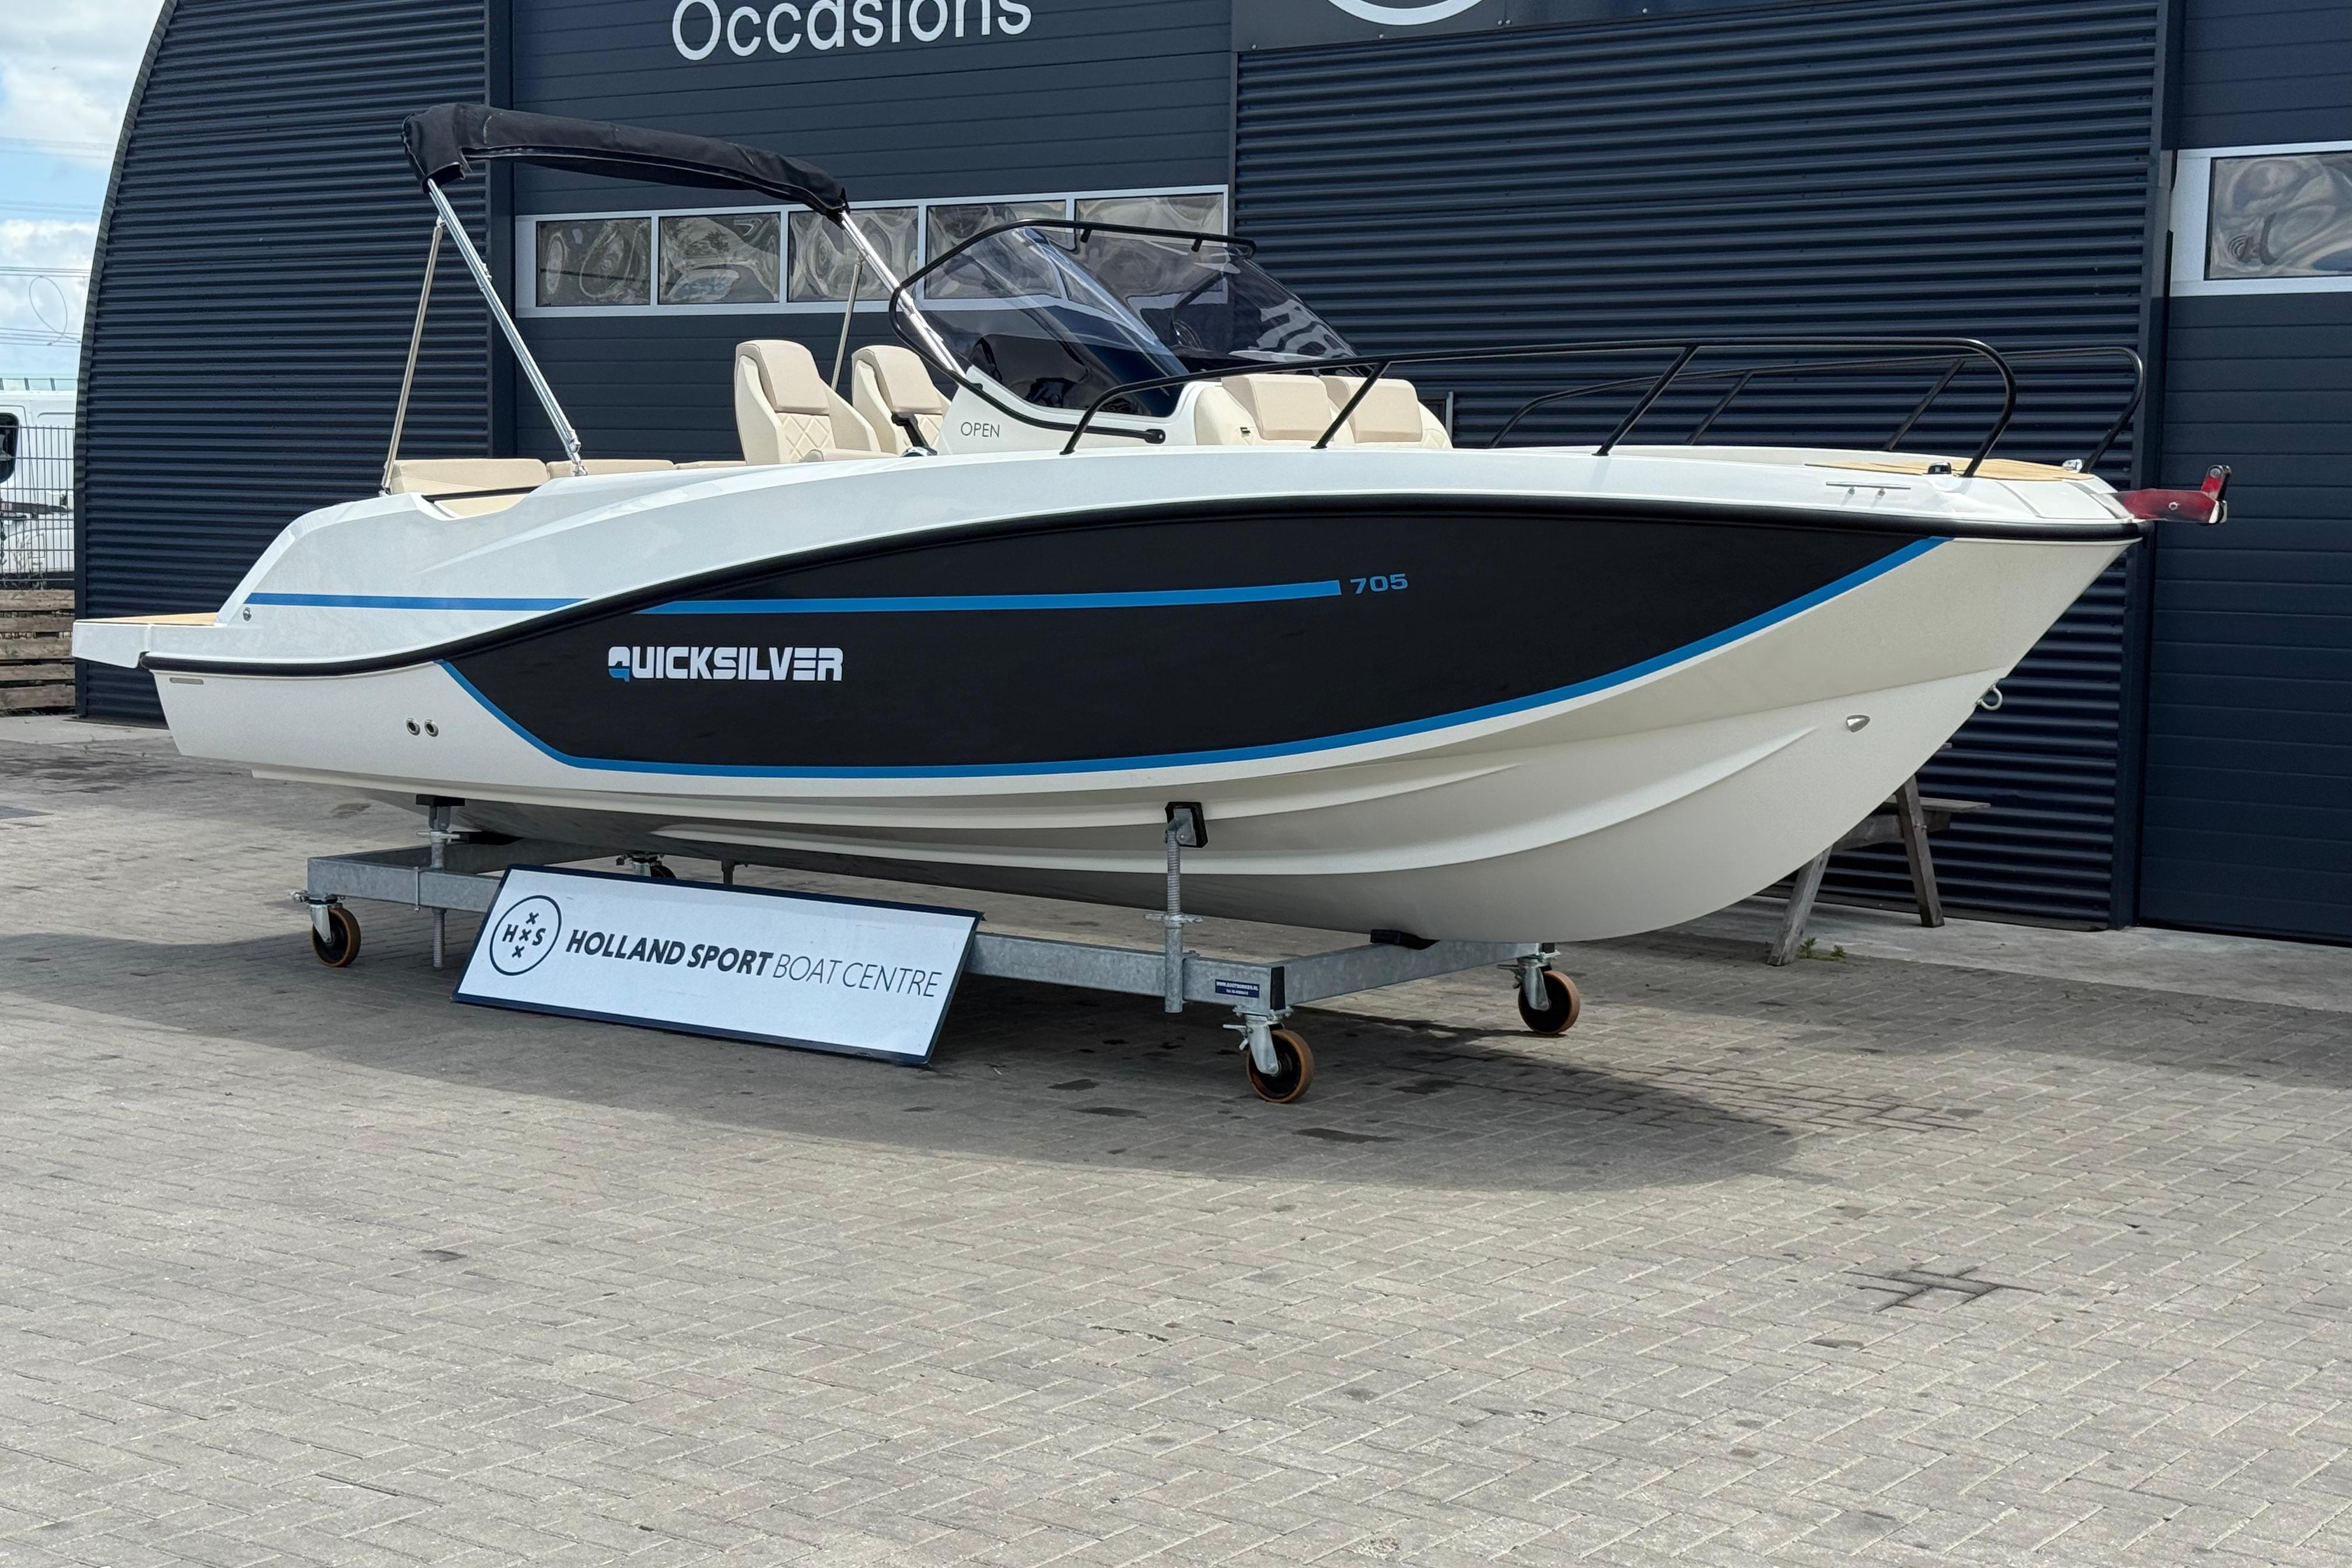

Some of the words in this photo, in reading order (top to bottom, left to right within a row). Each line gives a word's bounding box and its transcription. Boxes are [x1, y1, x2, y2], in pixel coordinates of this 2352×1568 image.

[672, 0, 1032, 61] Occasions
[960, 421, 1000, 438] OPEN
[1349, 573, 1408, 595] 705
[607, 646, 844, 682] QUICKSILVER
[565, 929, 686, 965] HOLLAND
[687, 944, 774, 976] SPORT
[773, 954, 843, 984] BOAT
[842, 963, 942, 998] CENTRE
